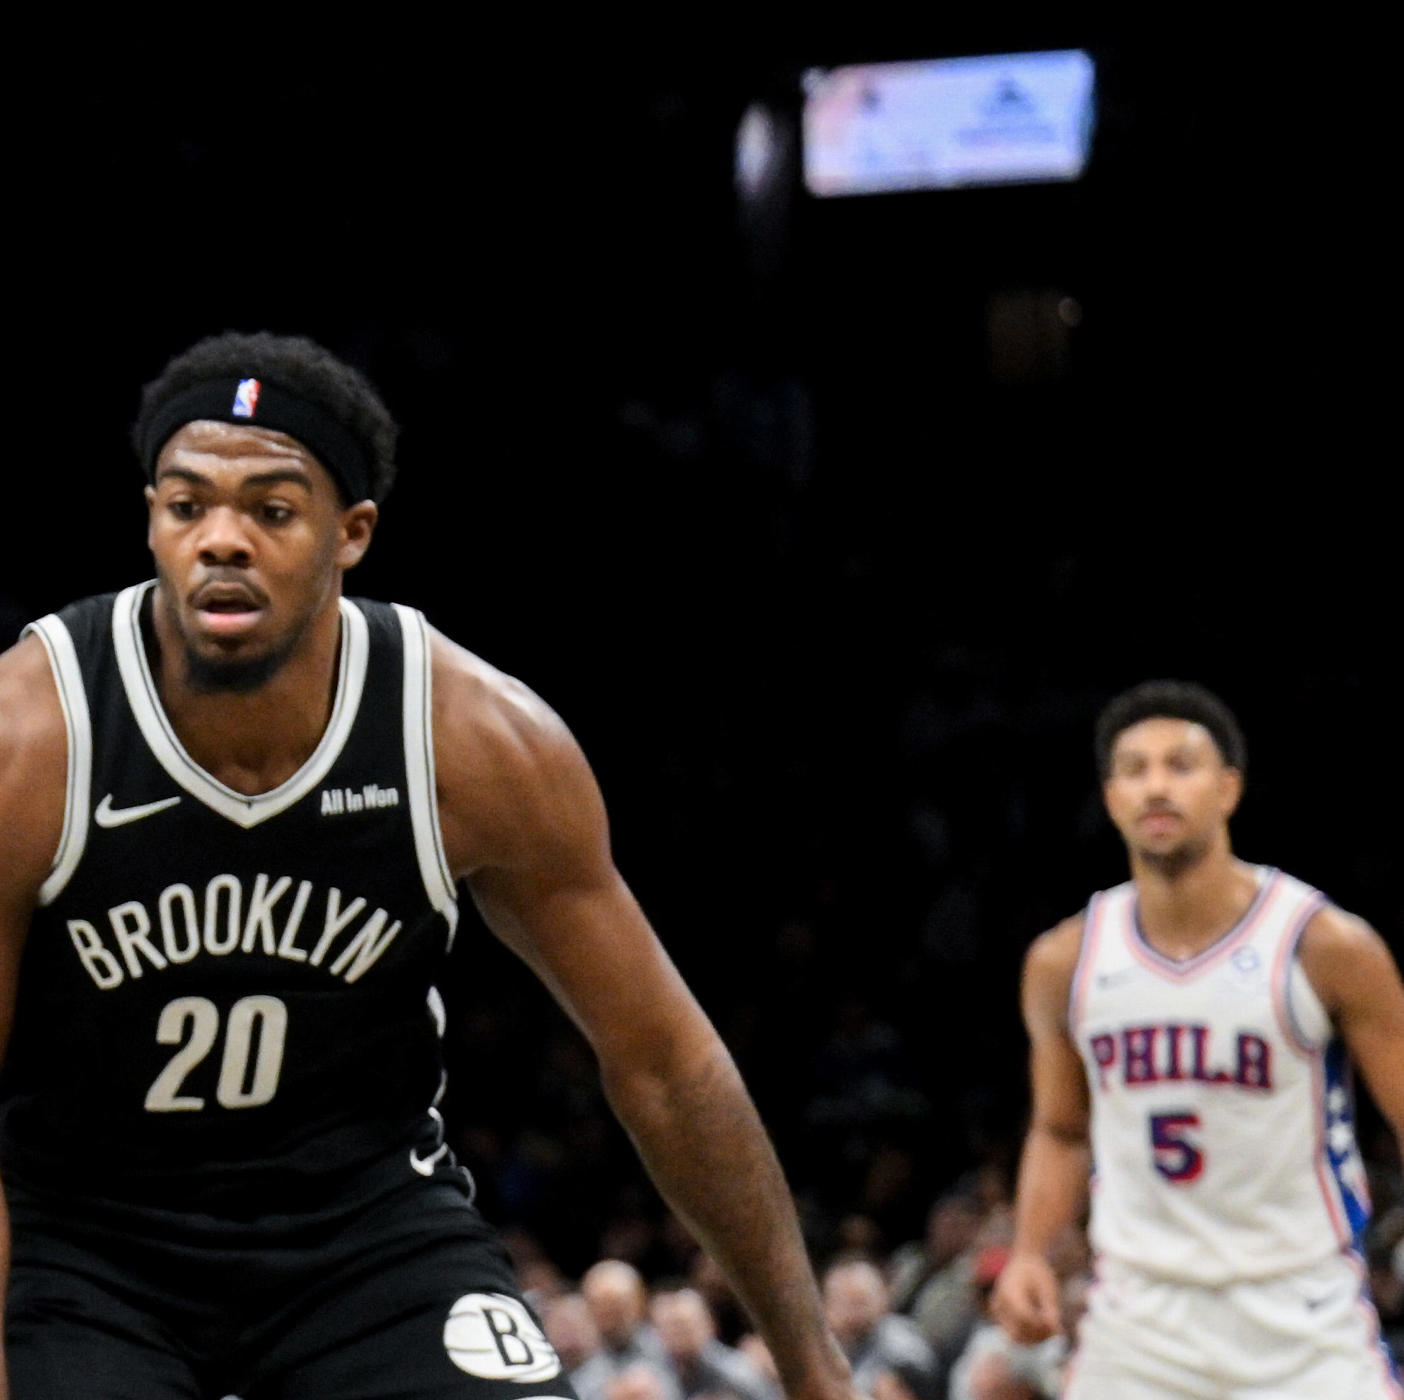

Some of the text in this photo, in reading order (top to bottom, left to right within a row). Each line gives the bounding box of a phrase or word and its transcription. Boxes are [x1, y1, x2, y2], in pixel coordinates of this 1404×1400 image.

[321, 784, 399, 816] All In Won
[66, 872, 402, 990] BROOKLYN
[144, 995, 288, 1113] 20
[1090, 1025, 1273, 1092] PHILA
[1149, 1112, 1204, 1182] 5
